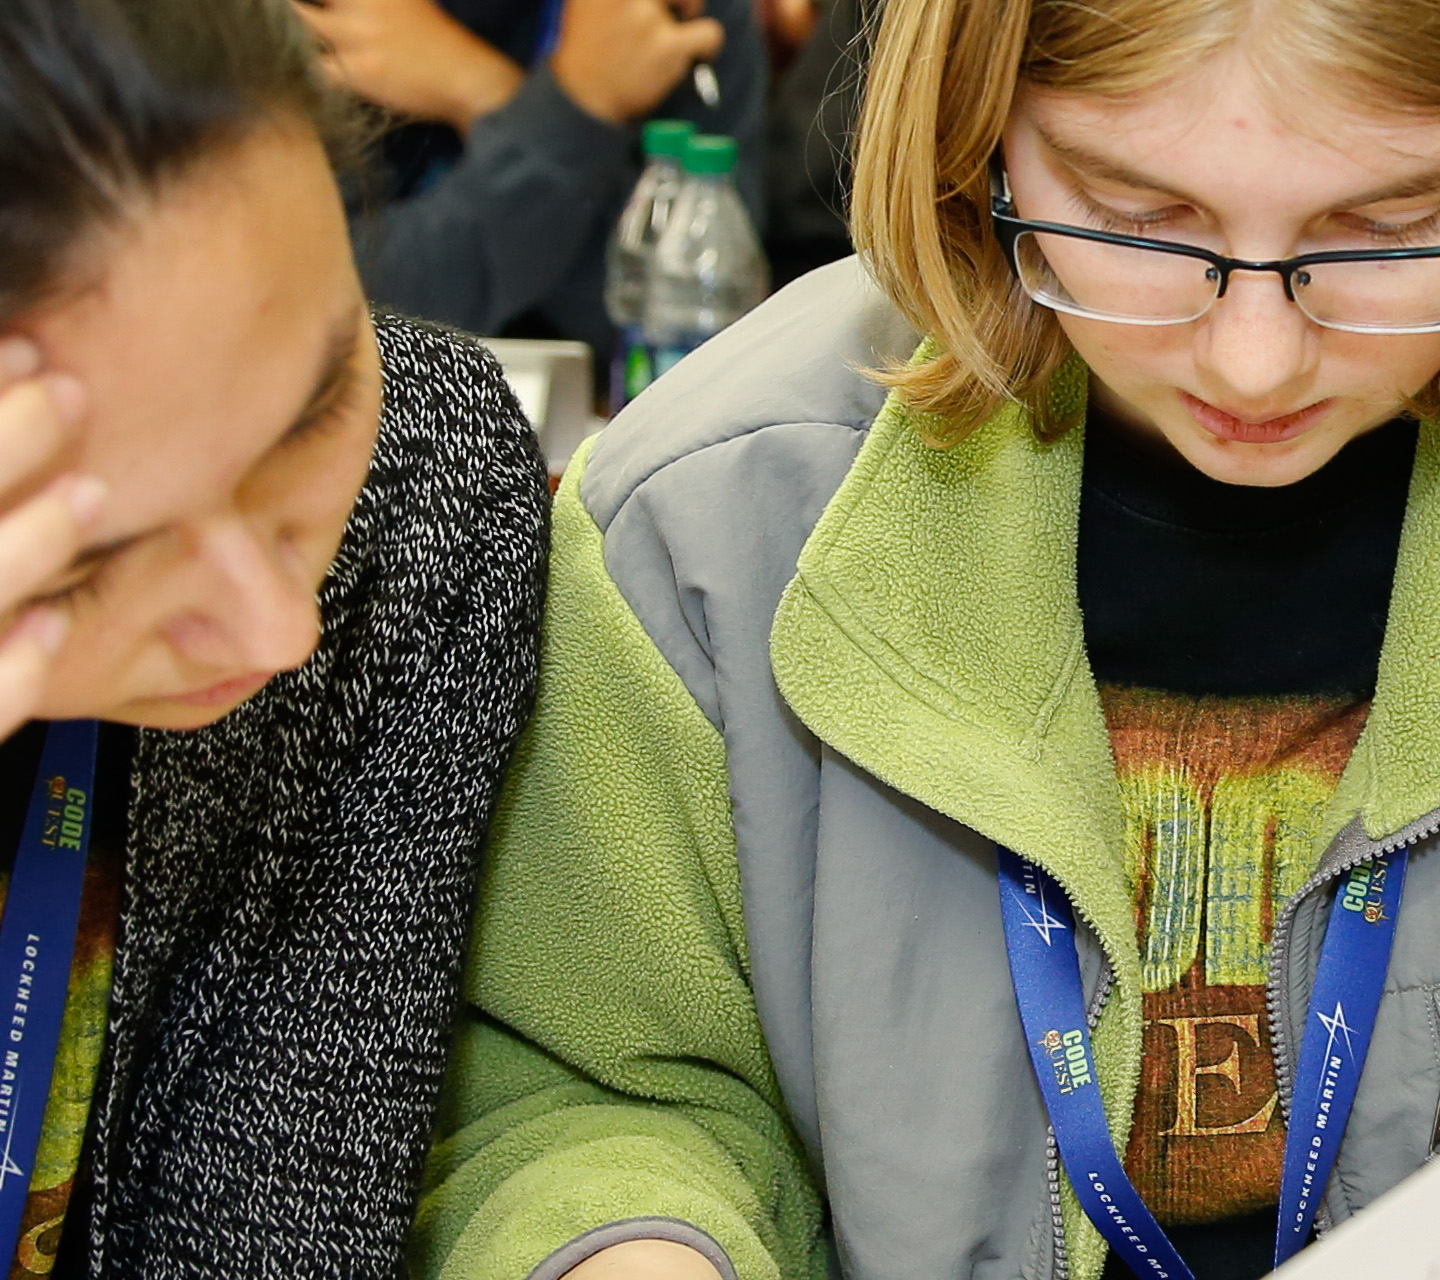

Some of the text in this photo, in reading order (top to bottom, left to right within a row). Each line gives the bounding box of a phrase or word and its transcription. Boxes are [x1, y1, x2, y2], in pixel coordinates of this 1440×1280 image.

[59, 787, 87, 851] CODE
[1022, 864, 1037, 894] TIN
[1341, 860, 1376, 913] COD
[9, 933, 40, 1043] LOCKHEED
[1037, 1028, 1075, 1097] QUEST
[1059, 1028, 1093, 1091] CODE
[1293, 1055, 1343, 1234] LOCKHEED MARTIN
[1087, 1170, 1148, 1255] LOCKHEED
